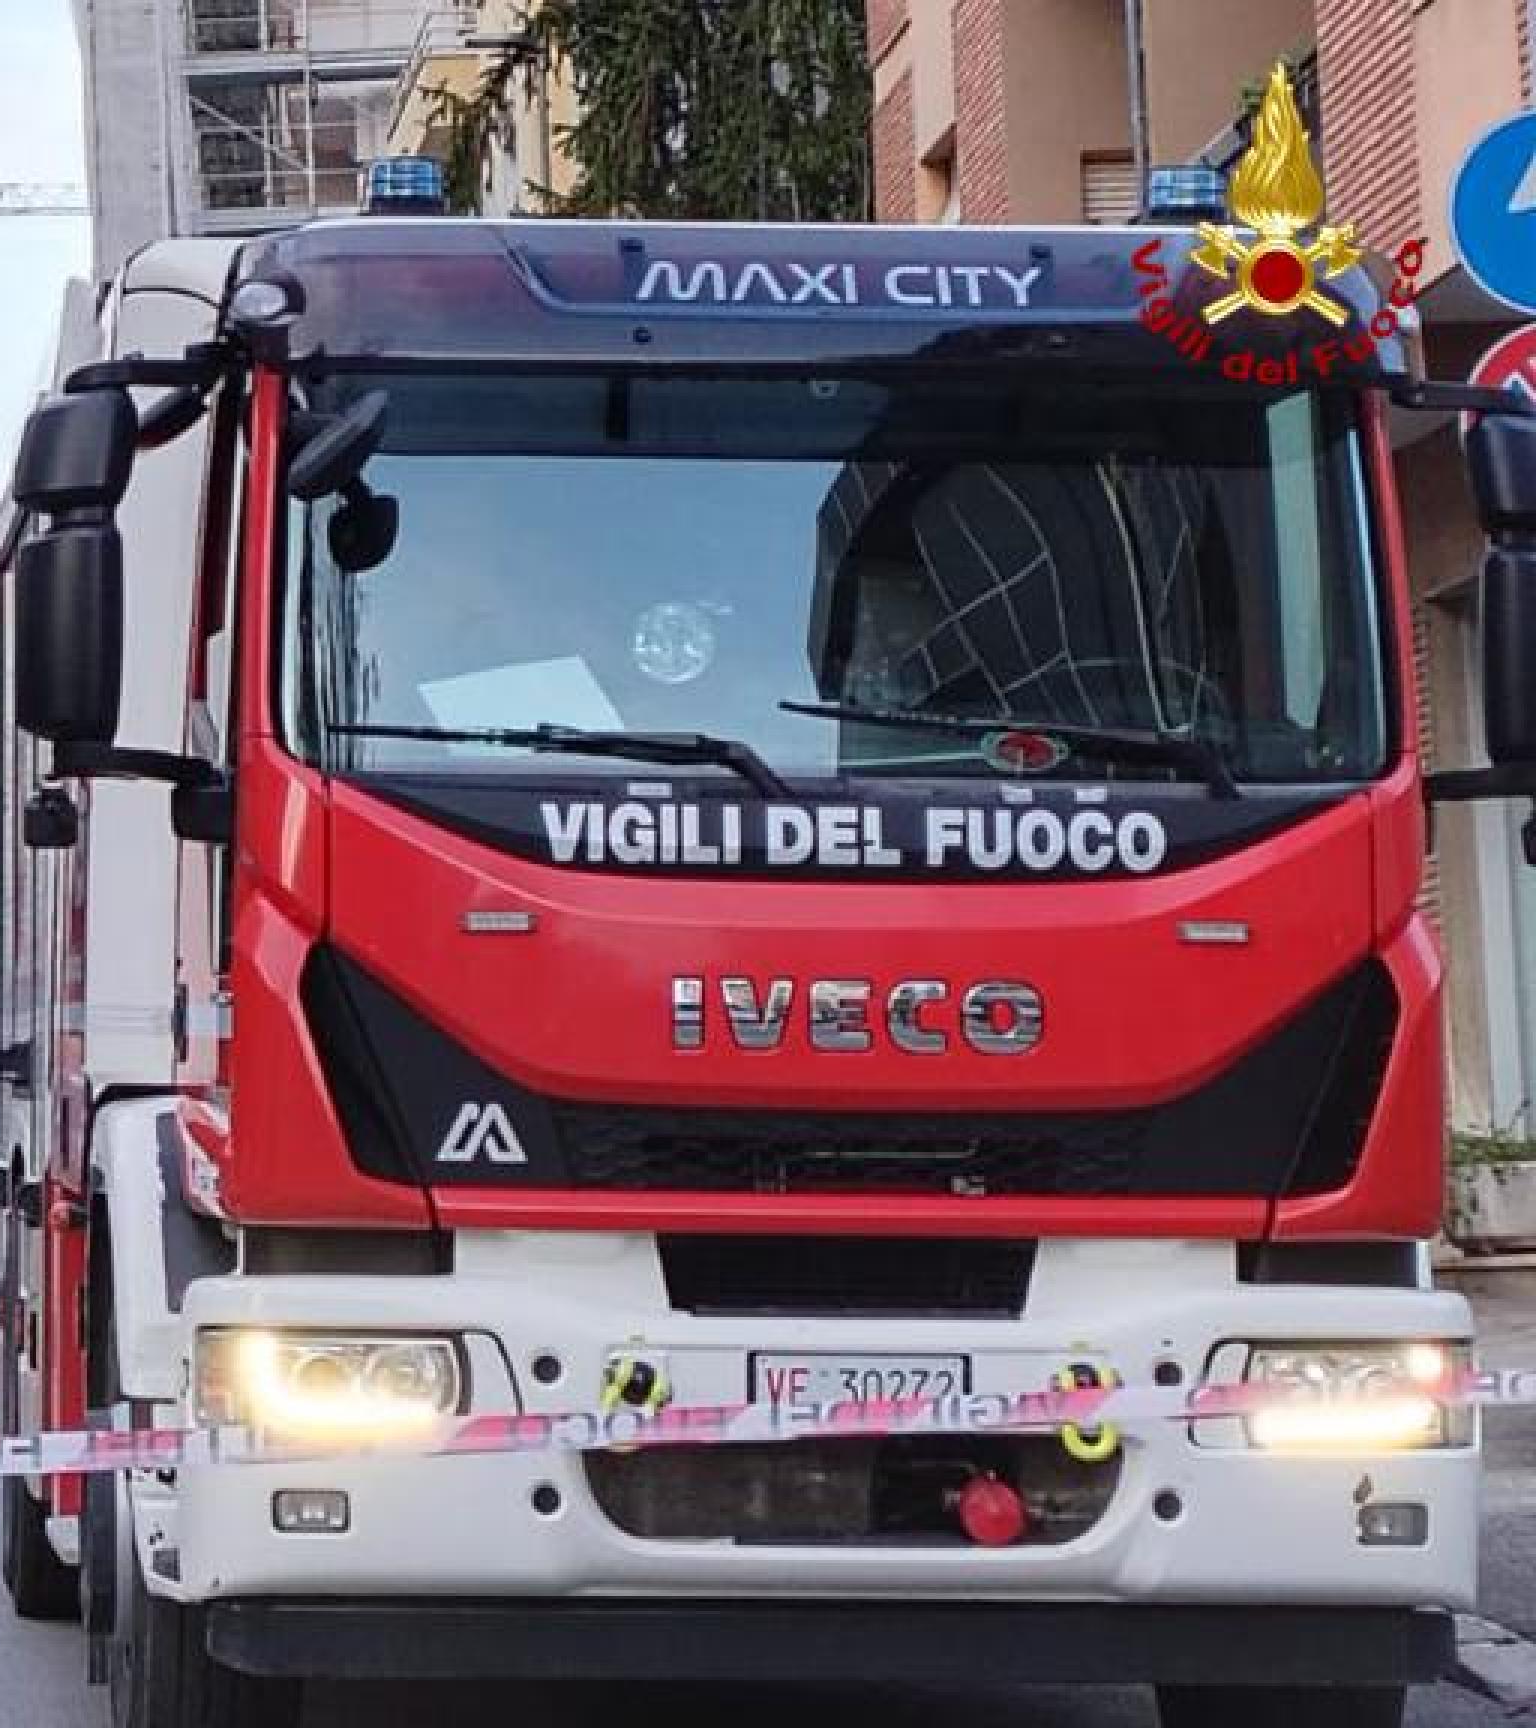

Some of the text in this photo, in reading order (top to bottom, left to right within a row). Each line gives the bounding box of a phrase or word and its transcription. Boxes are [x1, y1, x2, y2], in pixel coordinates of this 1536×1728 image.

[635, 261, 1043, 307] MAXI CITY
[541, 802, 1166, 872] VIGILI DEL FUOCO
[670, 976, 1046, 1056] IVECO
[839, 1367, 954, 1405] 30272
